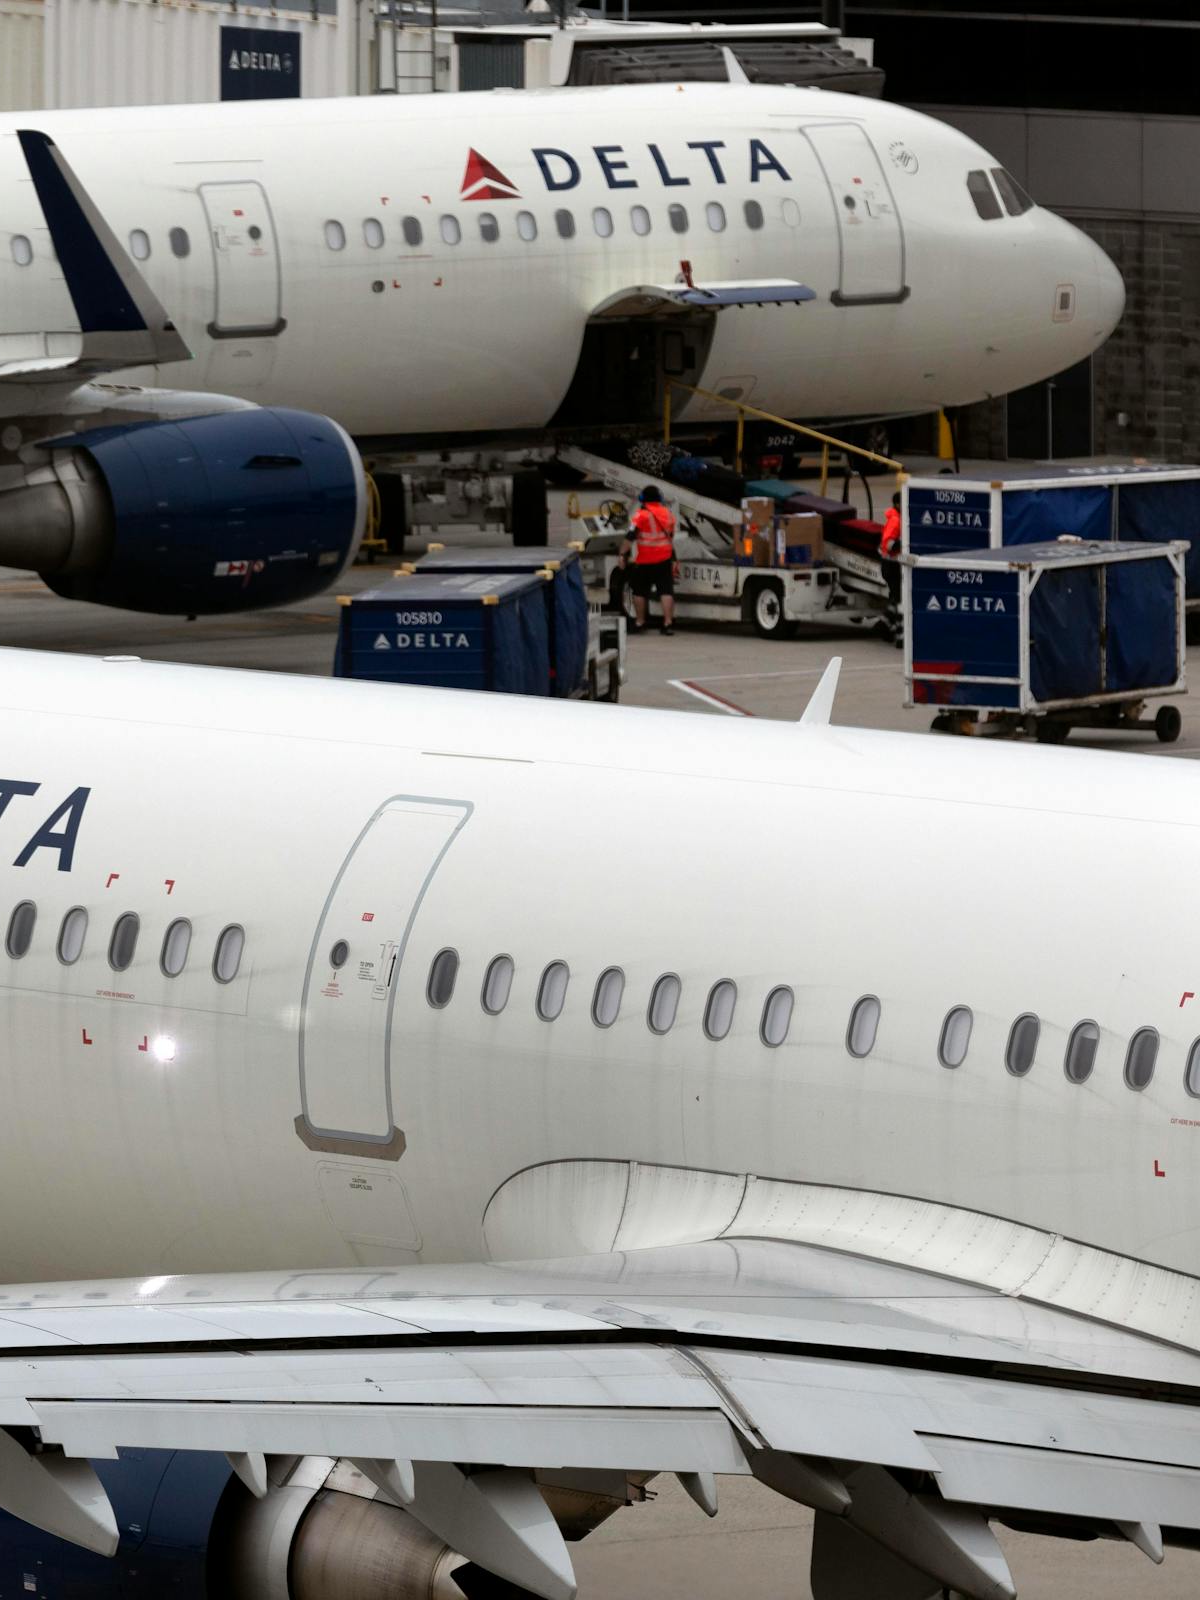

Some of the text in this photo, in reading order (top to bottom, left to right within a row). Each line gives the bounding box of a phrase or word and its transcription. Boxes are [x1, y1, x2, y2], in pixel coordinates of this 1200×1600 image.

[241, 50, 281, 72] DELTA
[531, 139, 793, 191] DELTA
[935, 490, 966, 504] 105786
[936, 511, 982, 527] DELTA
[684, 566, 721, 581] DELTA
[948, 571, 983, 584] 95474
[946, 596, 1006, 613] DELTA
[396, 611, 443, 625] 105810
[397, 632, 470, 648] DELTA
